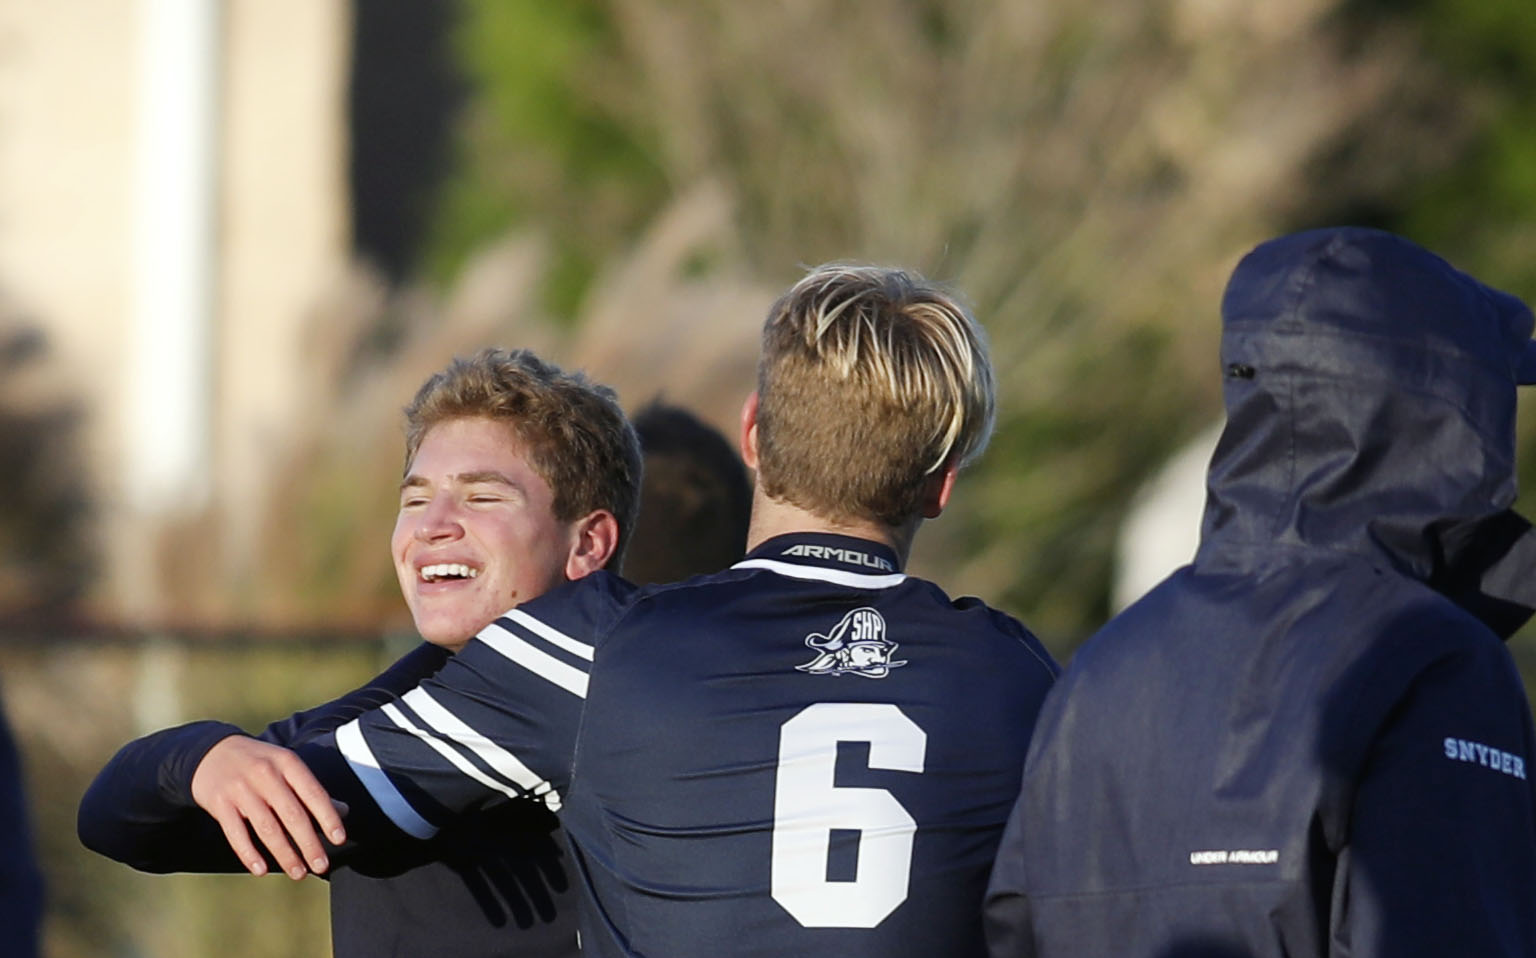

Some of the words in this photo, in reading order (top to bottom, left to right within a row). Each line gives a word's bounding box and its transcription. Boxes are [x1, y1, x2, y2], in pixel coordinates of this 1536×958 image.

[781, 545, 894, 572] ARMOUR
[851, 611, 882, 641] SHP
[1444, 737, 1526, 779] SNYDER
[771, 702, 927, 928] 6
